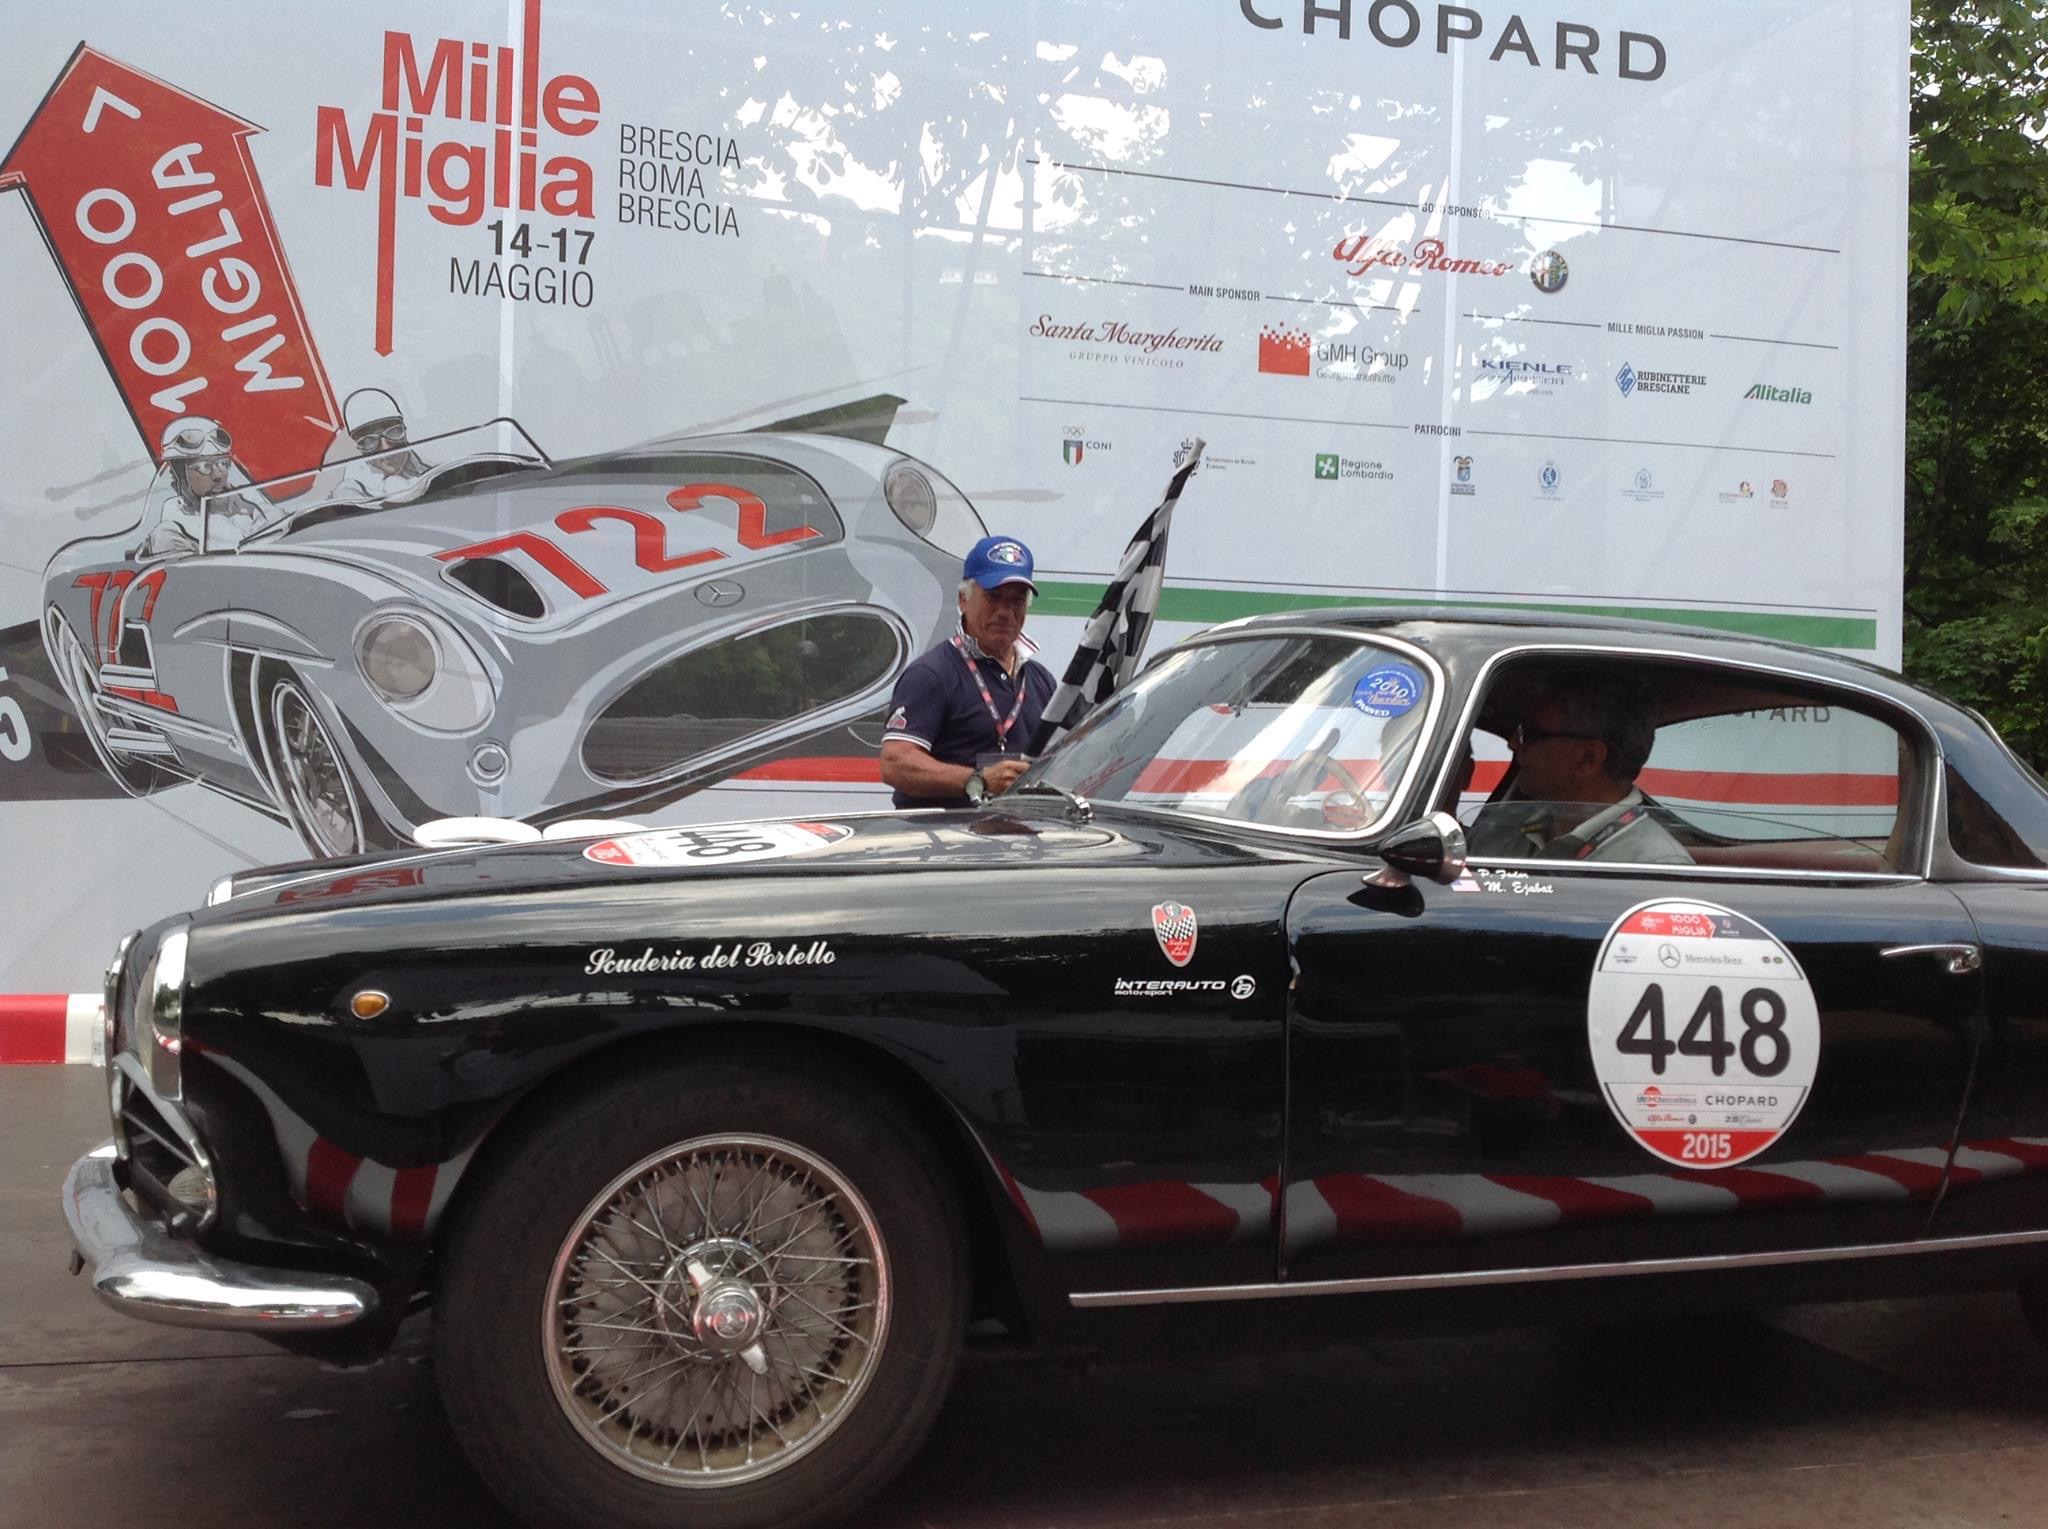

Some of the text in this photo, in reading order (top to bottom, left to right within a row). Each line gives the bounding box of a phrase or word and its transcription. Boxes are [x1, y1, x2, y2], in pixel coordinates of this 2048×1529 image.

[1238, 0, 1667, 82] CHOPARD
[382, 0, 601, 137] Mille
[618, 123, 742, 170] BRESCIA
[315, 105, 597, 227] Miglia
[618, 158, 705, 199] ROMA
[617, 192, 741, 239] BRESCIA
[487, 219, 596, 265] 14-17
[150, 142, 305, 393] MIGLIA
[449, 256, 594, 308] MAGGIO
[75, 187, 208, 414] 1000
[1189, 285, 1261, 301] MAIN SPONSOR
[1029, 313, 1225, 354] Santa Margherita
[1607, 322, 1704, 340] MILLE MIGLIA PASSION
[1068, 351, 1185, 369] GRUPPO VINICOLO
[1317, 343, 1409, 371] GMH Group
[1481, 359, 1573, 375] KIENLE
[1636, 382, 1690, 395] BRESCIANE
[1637, 370, 1708, 386] RUBINETTERIE
[1743, 383, 1813, 405] Alitalia
[1085, 440, 1112, 451] CONI
[1414, 423, 1462, 437] PATROCINI
[1340, 457, 1383, 470] Regione
[1340, 469, 1394, 481] Lombardia
[431, 482, 824, 600] 722
[584, 940, 837, 976] Scuderia del Portello
[1615, 982, 1792, 1078] 448
[1705, 1094, 1779, 1107] CHOPARD
[1681, 1133, 1732, 1159] 2015
